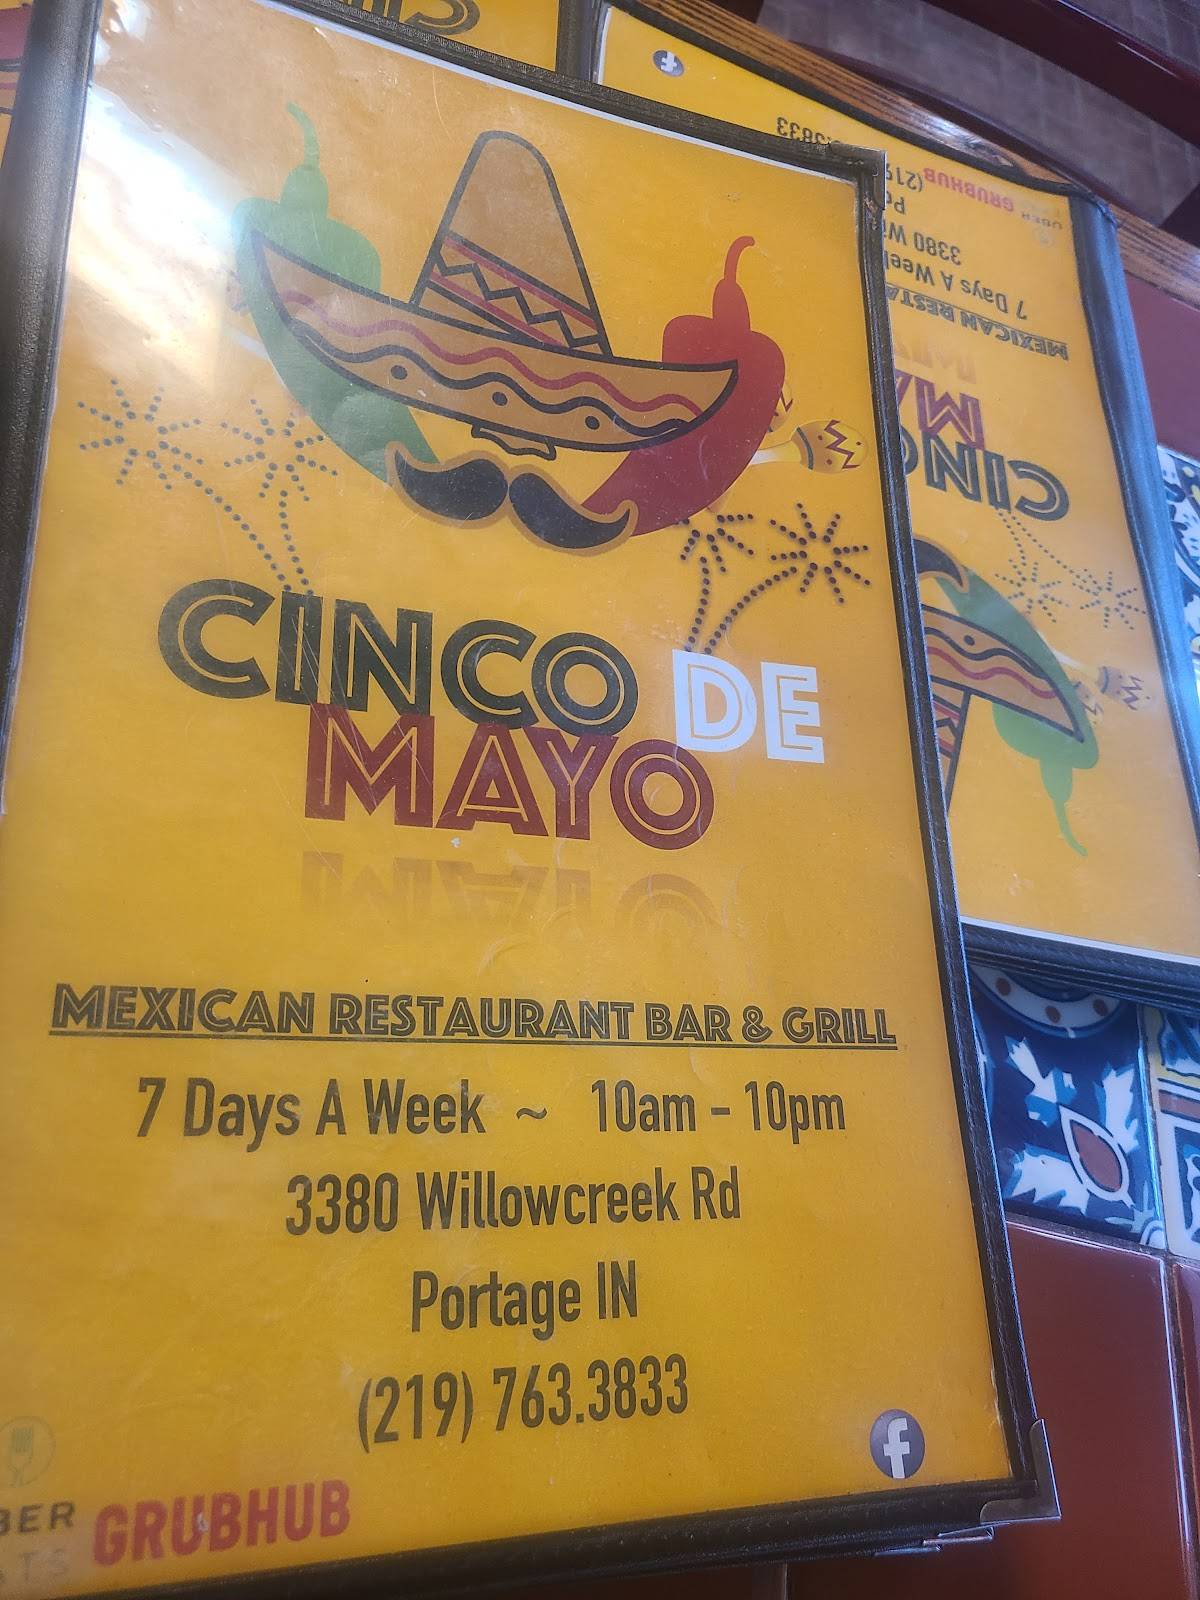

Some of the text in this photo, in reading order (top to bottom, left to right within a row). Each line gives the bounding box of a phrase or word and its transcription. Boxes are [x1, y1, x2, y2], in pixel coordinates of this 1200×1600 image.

[923, 167, 1014, 212] GRUBHUB
[913, 232, 962, 266] 3380
[940, 270, 954, 292] A
[960, 278, 1009, 315] Days
[1016, 300, 1029, 321] 7
[960, 310, 1070, 362] MEXICAN
[157, 578, 825, 764] CINCO DE
[304, 702, 715, 851] MAYO
[51, 982, 898, 1045] MEXICAN RESTAURANT BAR & GRILL
[136, 1077, 167, 1138] 7
[182, 1077, 301, 1153] Days
[315, 1078, 347, 1136] A
[362, 1078, 487, 1136] Week
[590, 1079, 697, 1133] 10am
[743, 1080, 847, 1145] 10pm
[285, 1165, 742, 1236] 3380 Willowcreek Rd
[411, 1259, 639, 1342] Portage IN
[357, 1352, 689, 1454] (219) 763.3833
[92, 1479, 351, 1568] GRUBHUB
